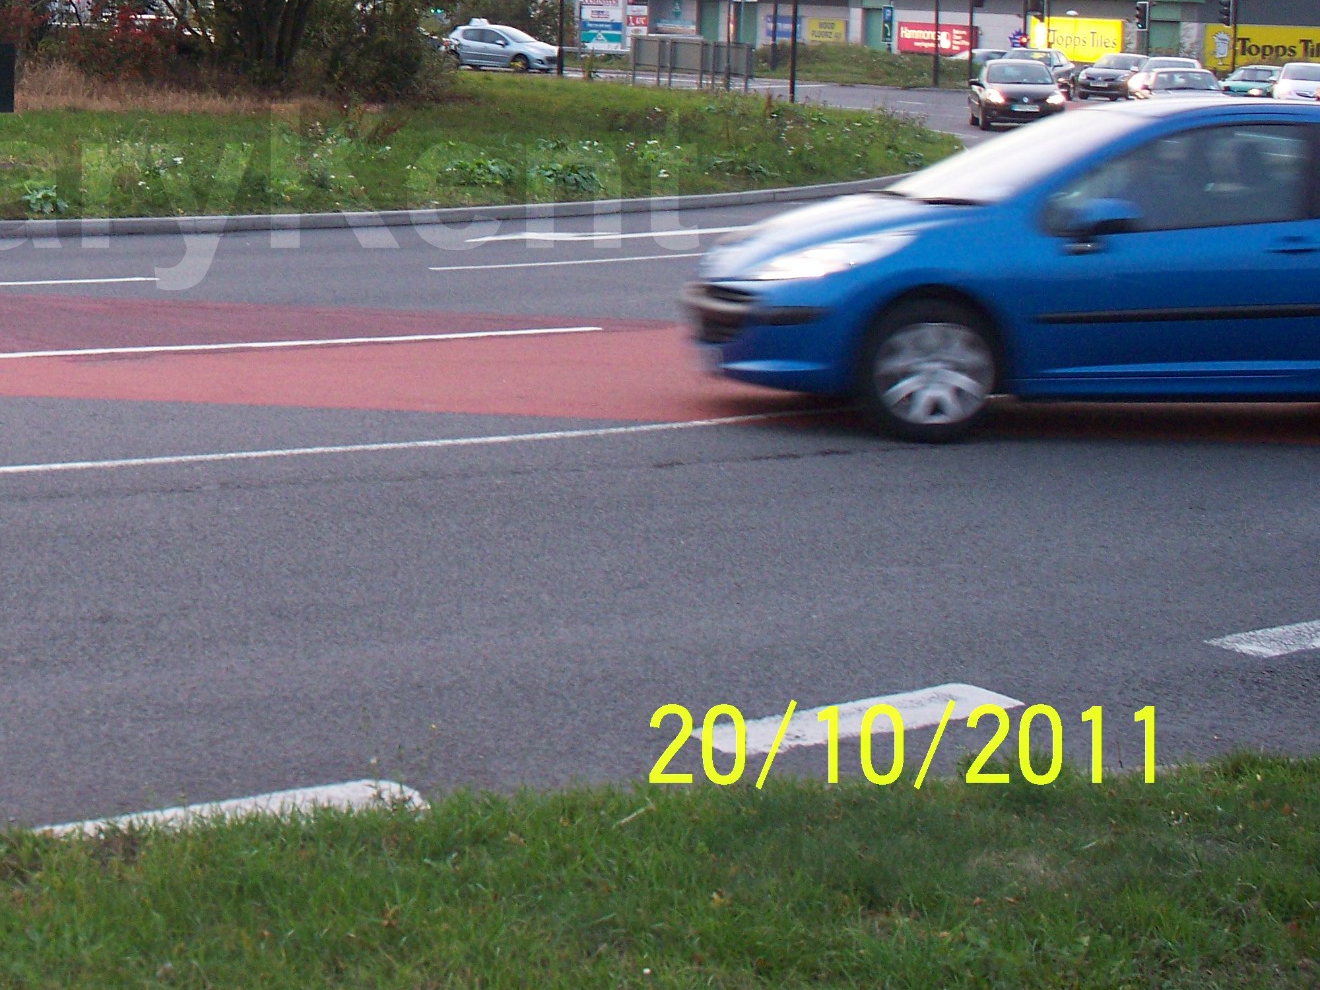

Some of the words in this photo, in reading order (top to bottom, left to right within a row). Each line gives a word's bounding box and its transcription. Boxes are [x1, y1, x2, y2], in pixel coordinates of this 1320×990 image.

[1048, 29, 1087, 49] Topps
[1090, 31, 1118, 49] Tiles
[1237, 37, 1297, 60] Topps
